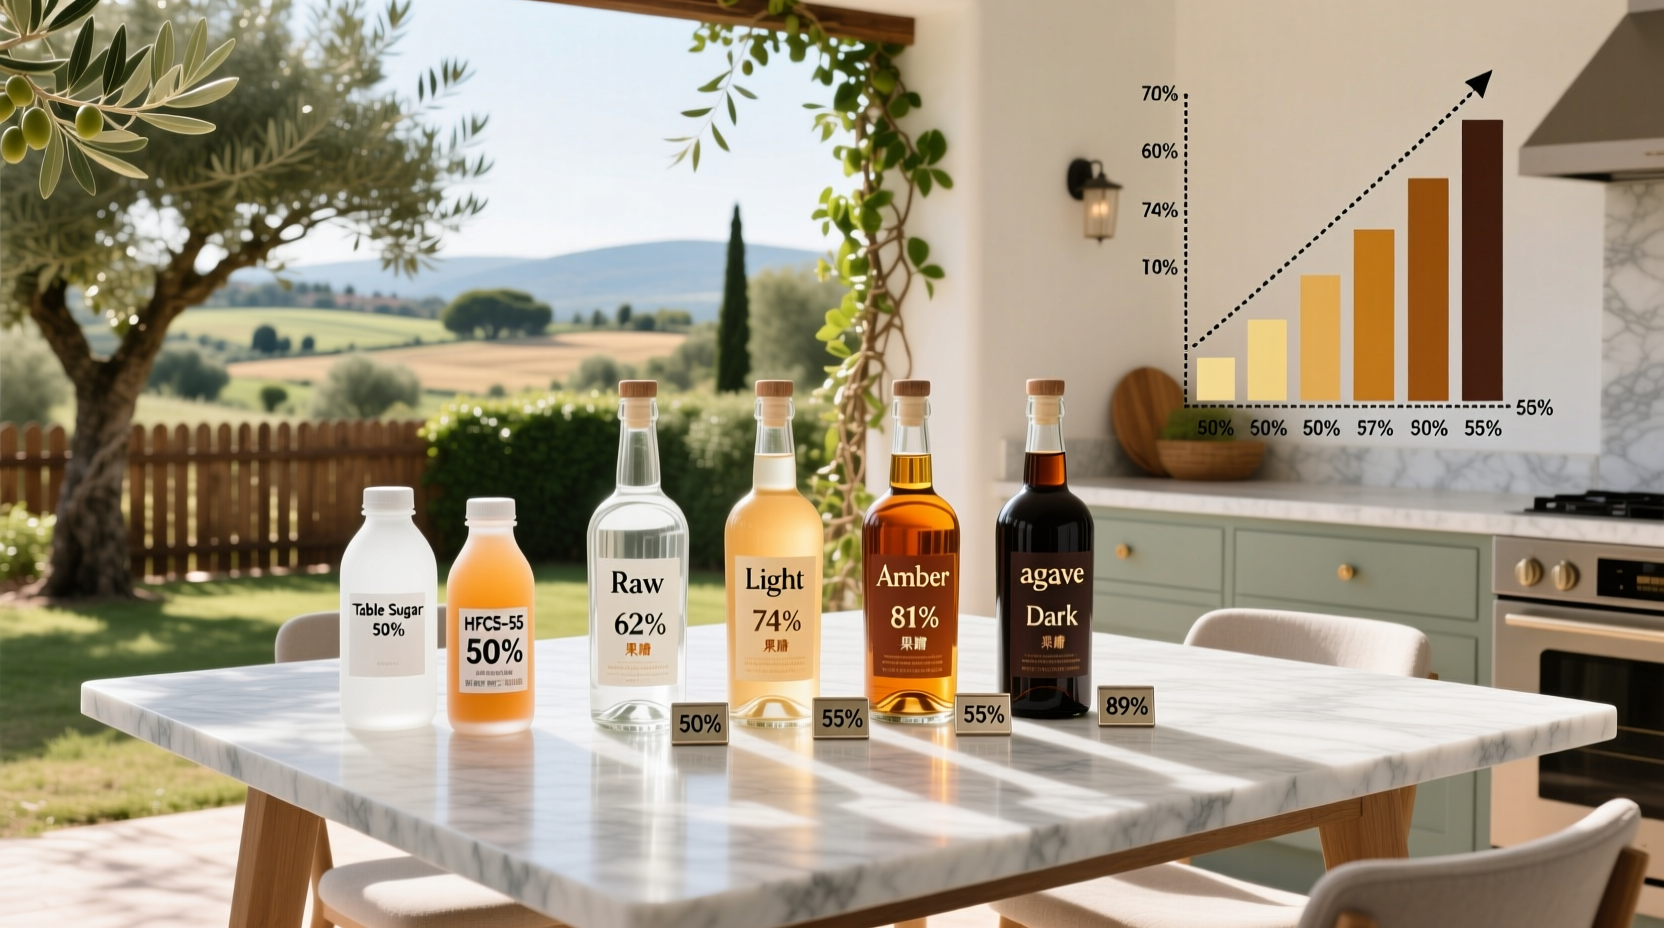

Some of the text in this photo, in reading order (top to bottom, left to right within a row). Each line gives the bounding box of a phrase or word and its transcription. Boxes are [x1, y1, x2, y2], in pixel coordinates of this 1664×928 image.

[611, 570, 665, 594] Raw
[745, 567, 805, 597] Light
[876, 564, 950, 588] Amber
[1019, 565, 1085, 592] agave
[352, 602, 424, 619] Table Sugar
[753, 609, 801, 632] 74%
[890, 605, 939, 629] 81%
[1026, 604, 1078, 627] Dark
[372, 622, 405, 637] 50%
[614, 612, 666, 636] 62%
[466, 637, 523, 664] 50%
[963, 704, 1005, 724] 55%
[1106, 696, 1149, 716] 89%
[679, 714, 721, 734] 50%
[822, 708, 863, 728] 55%
